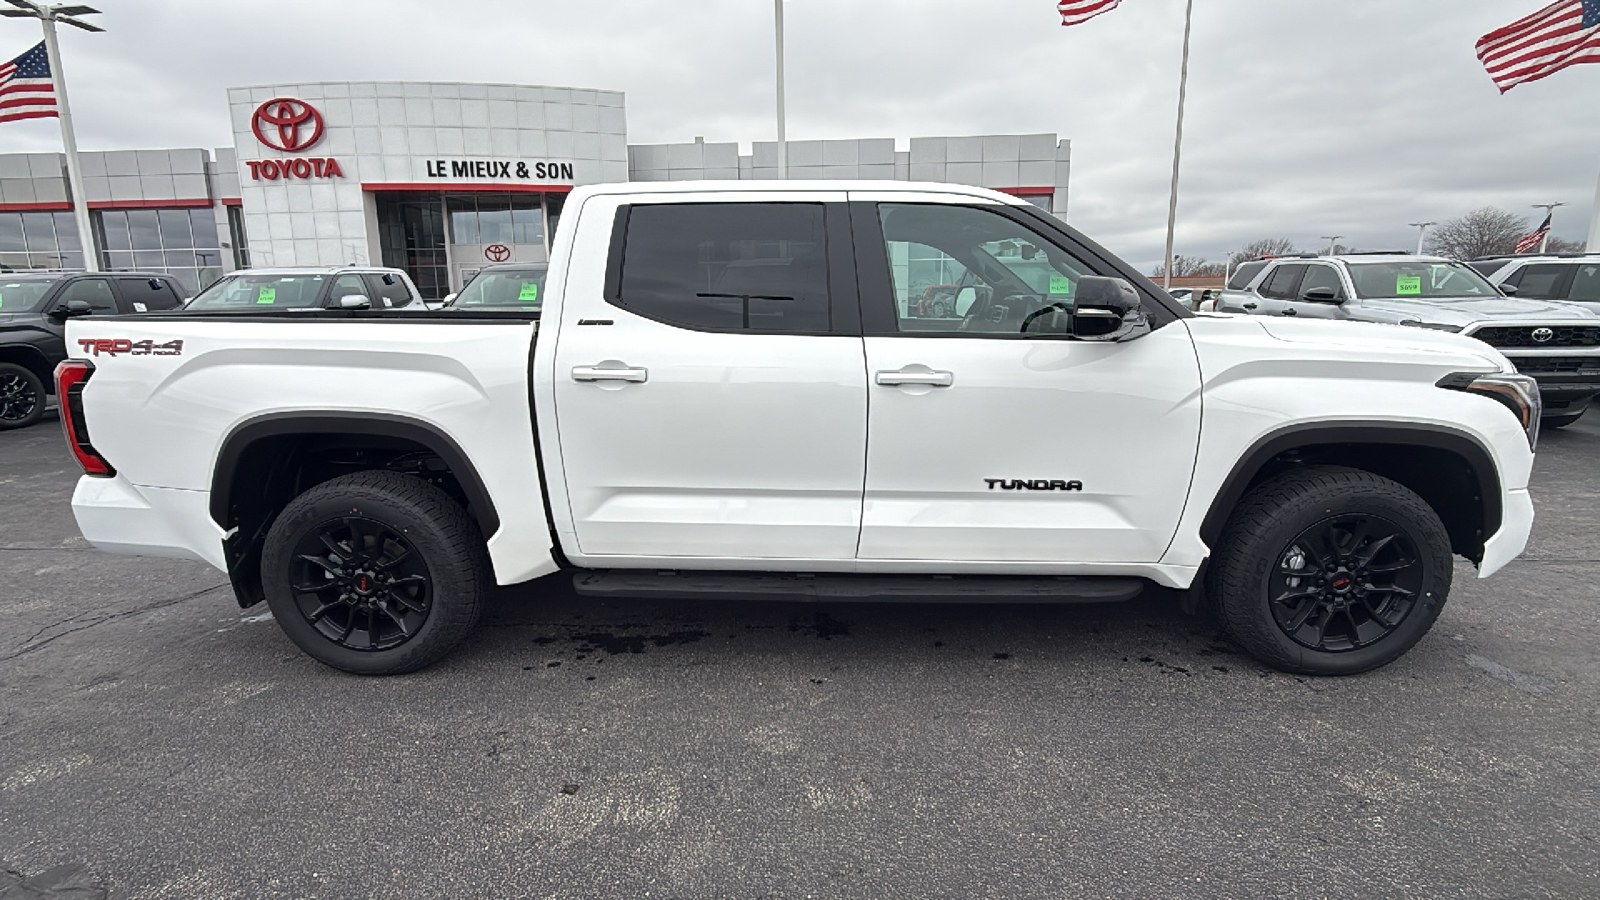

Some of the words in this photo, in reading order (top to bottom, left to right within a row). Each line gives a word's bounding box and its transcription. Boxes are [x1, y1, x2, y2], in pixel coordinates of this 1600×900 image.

[246, 158, 343, 180] TOYOTA
[427, 160, 447, 177] LE
[451, 160, 511, 178] MIEUX
[516, 161, 530, 178] &
[535, 162, 574, 179] SON
[78, 339, 132, 357] TRD
[984, 479, 1082, 490] TUNDRA
